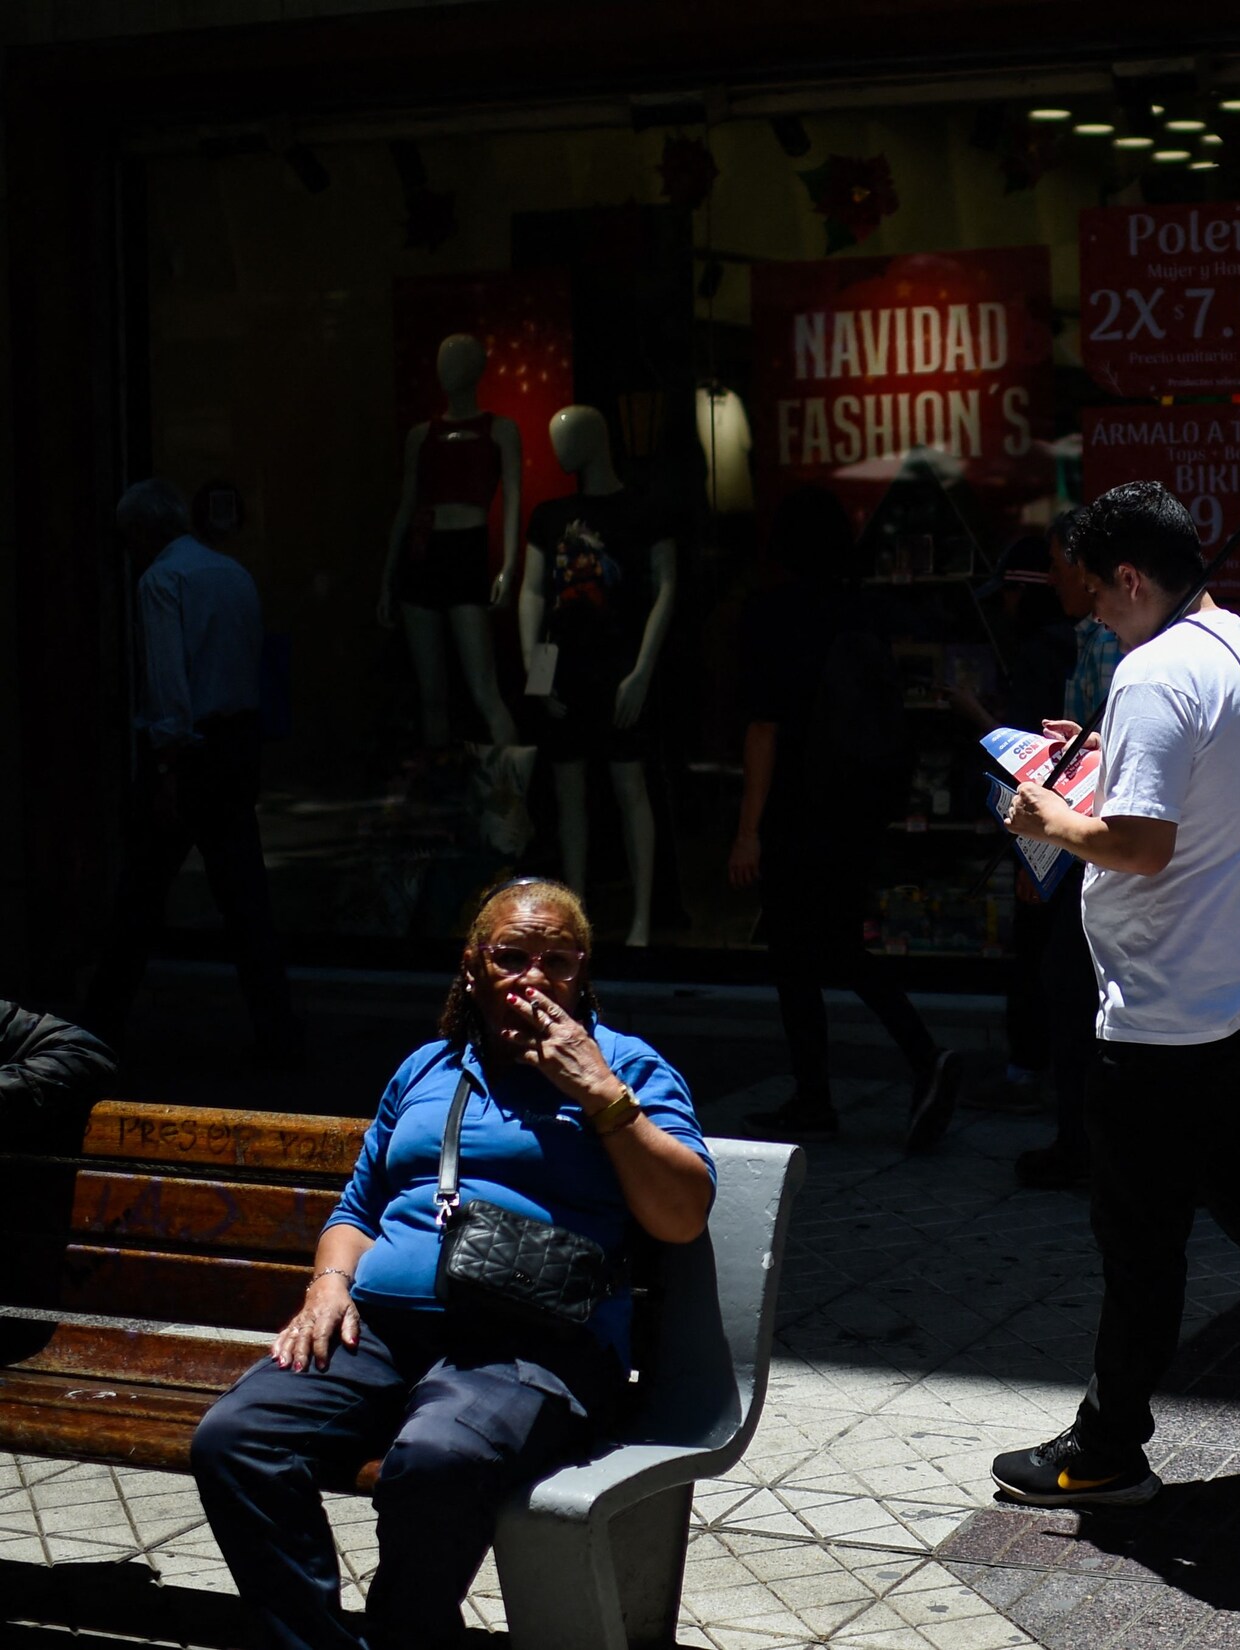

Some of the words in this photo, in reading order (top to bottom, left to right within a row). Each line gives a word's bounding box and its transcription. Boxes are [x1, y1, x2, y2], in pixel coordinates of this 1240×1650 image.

[1147, 263, 1198, 281] Mujer
[1200, 264, 1210, 280] y
[1088, 287, 1167, 341] 2X
[793, 301, 1008, 380] NAVIDAD
[1128, 350, 1174, 364] Precio
[1091, 418, 1200, 446] ÁRMALO
[1207, 421, 1225, 443] A
[1167, 448, 1205, 464] Tops
